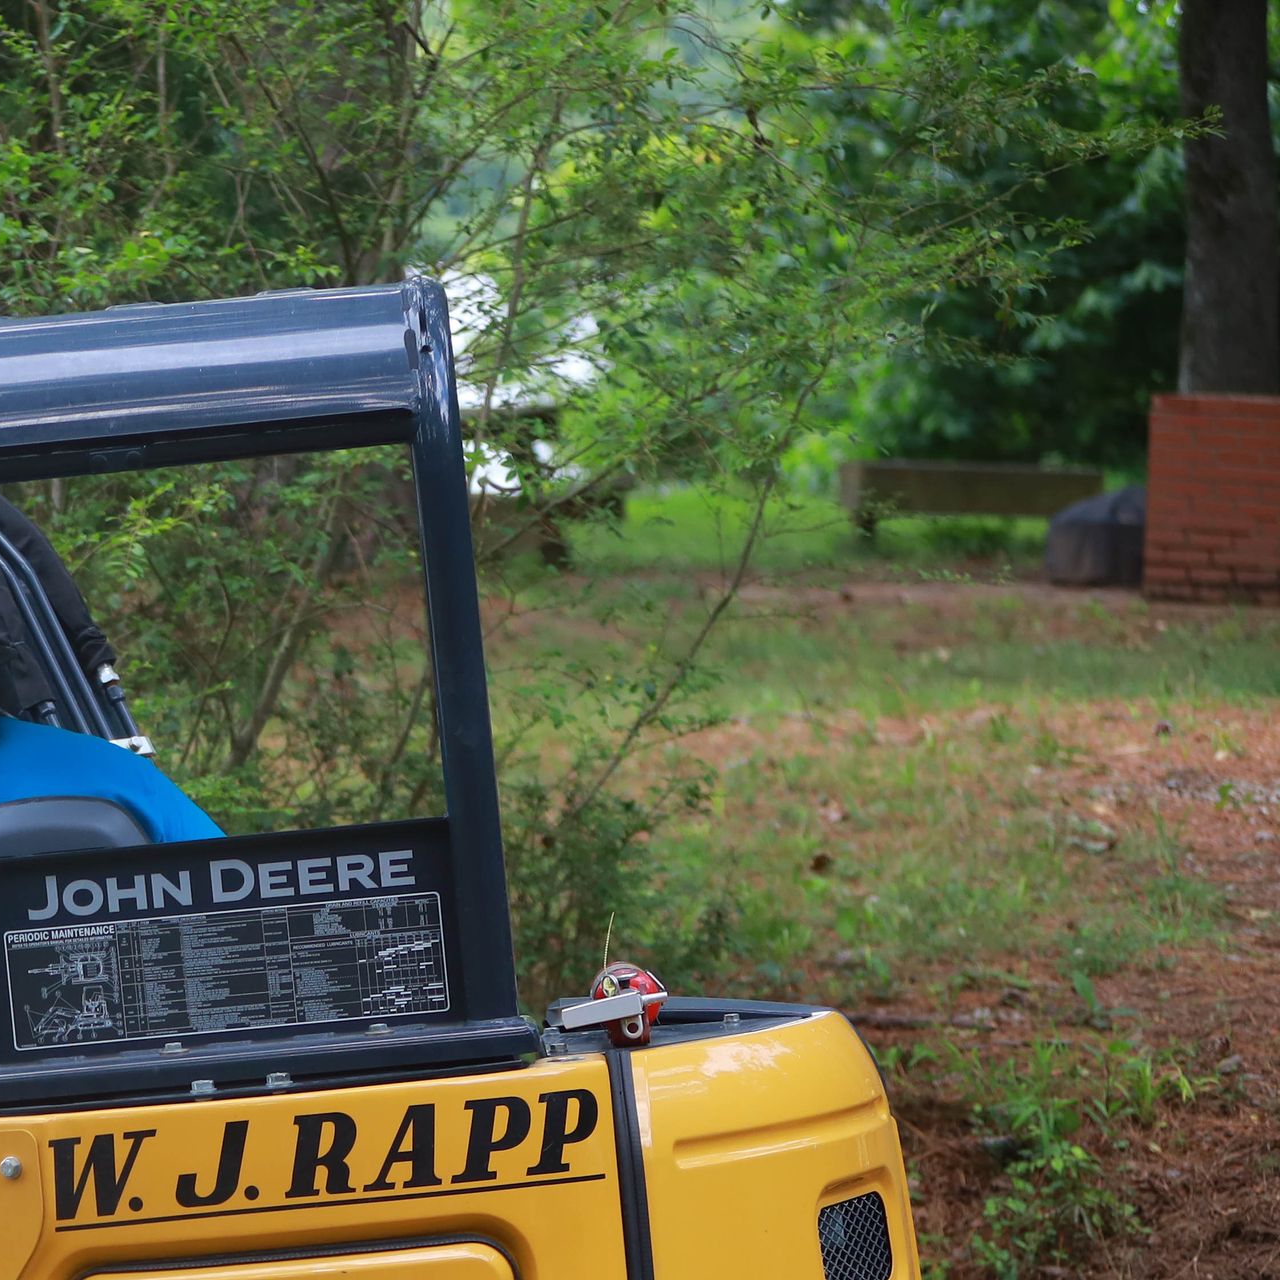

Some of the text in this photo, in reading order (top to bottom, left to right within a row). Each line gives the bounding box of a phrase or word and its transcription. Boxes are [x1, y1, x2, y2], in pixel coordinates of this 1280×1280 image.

[28, 849, 416, 921] JOHN DEERE
[7, 924, 115, 944] PERIODIC MAINTENANCE
[47, 1088, 600, 1221] W. J. RAPP
